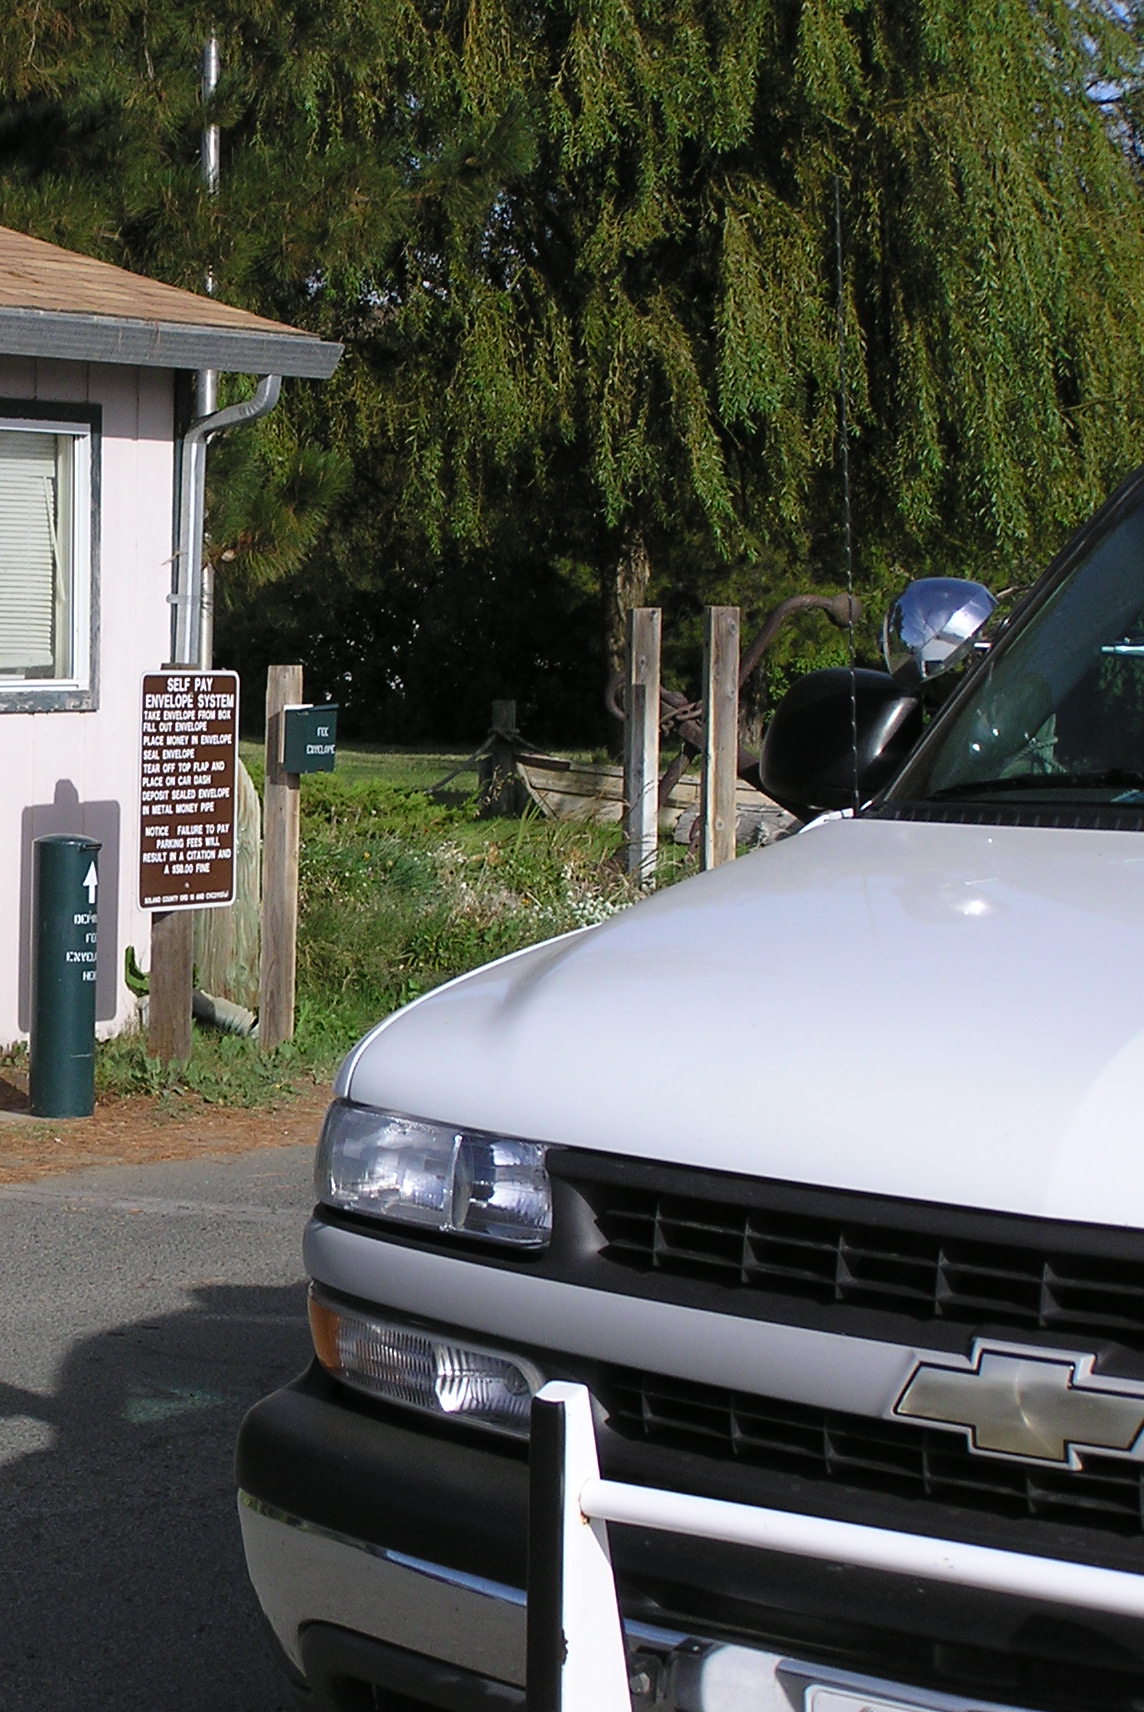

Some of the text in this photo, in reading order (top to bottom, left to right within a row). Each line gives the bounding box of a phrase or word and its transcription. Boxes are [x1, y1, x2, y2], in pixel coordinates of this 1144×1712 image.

[167, 678, 213, 692] SELF PAY
[146, 694, 234, 708] ENVELOPE SYSTEM
[144, 710, 231, 720] TAKE ENVELOPE FROM BOX
[143, 721, 207, 732] FILL OUT ENVELOPE
[144, 734, 232, 746] PLACE MONEY IN ENVELOPE
[144, 749, 195, 760] SEAL ENVELOPE
[143, 761, 225, 773] TEAR OFF TOP FLAP AND
[142, 775, 211, 787] PLACE ON CAR DASH
[142, 788, 230, 801] DEPOSIT SEALED ENVELOPE
[142, 802, 214, 815] IN METAL MONEY PIPE
[145, 824, 229, 836] NOTICE FAILURE TO PAY
[156, 837, 220, 849] PARKING FEES WILL
[143, 849, 231, 862] RESULT IN A CITATION AND
[164, 865, 169, 874] A
[196, 863, 210, 872] FINE
